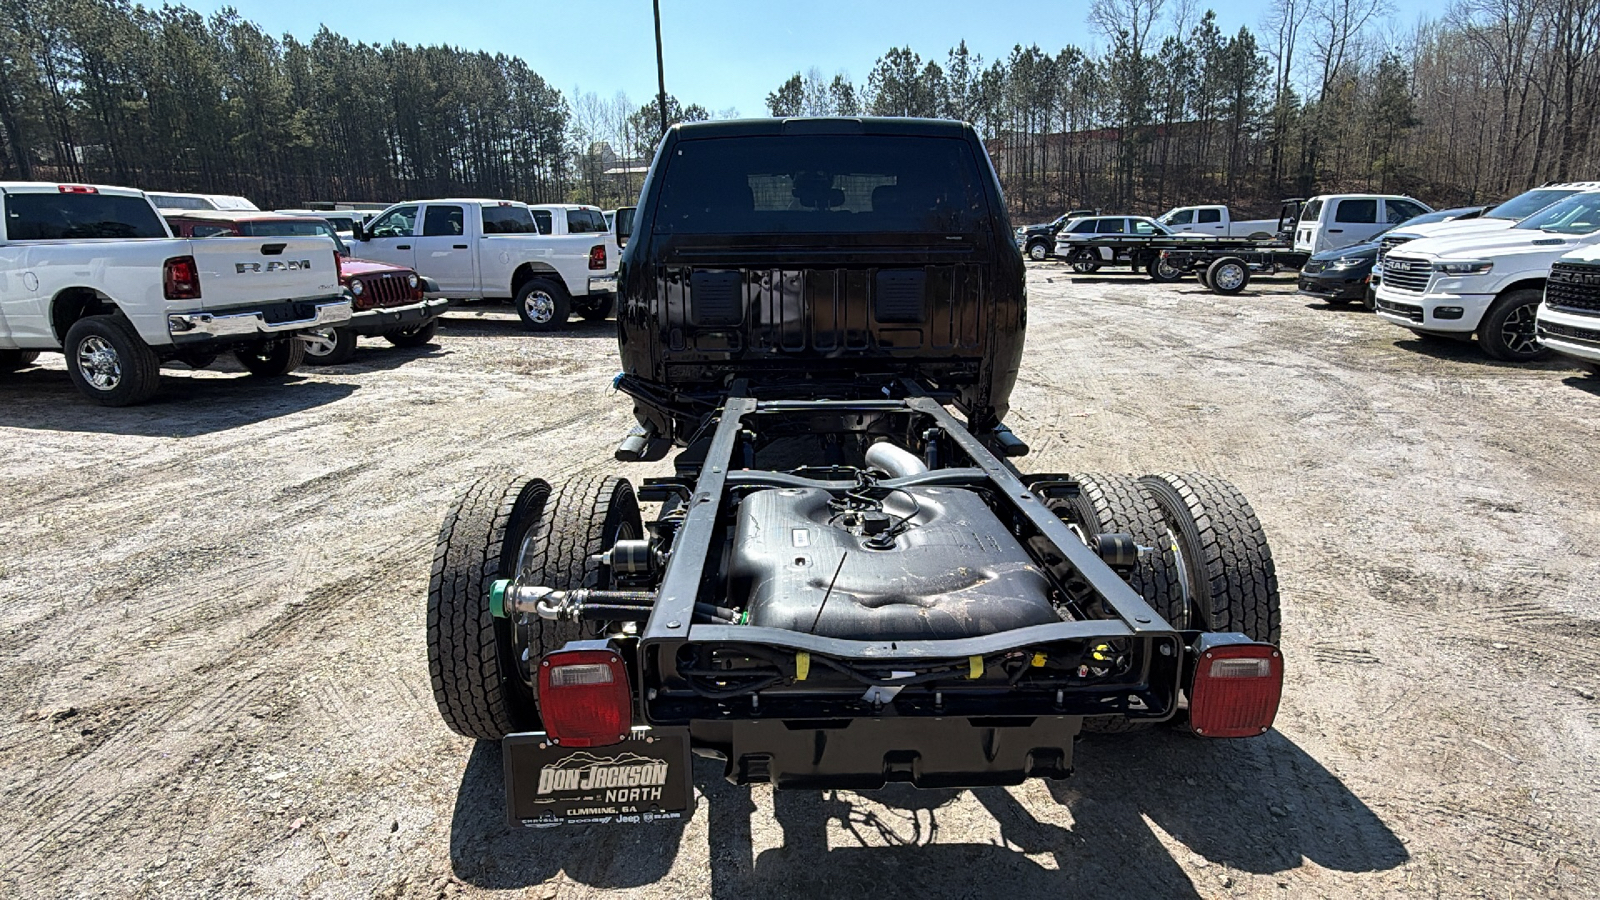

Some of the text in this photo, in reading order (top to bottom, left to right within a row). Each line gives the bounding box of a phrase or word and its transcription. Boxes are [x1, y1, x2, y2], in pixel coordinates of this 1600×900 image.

[235, 260, 311, 273] RAM
[1389, 261, 1411, 270] RAM
[1560, 272, 1600, 285] RAM
[537, 764, 669, 794] DON JACKSON
[605, 787, 662, 803] NORTH
[615, 814, 640, 823] Jeep
